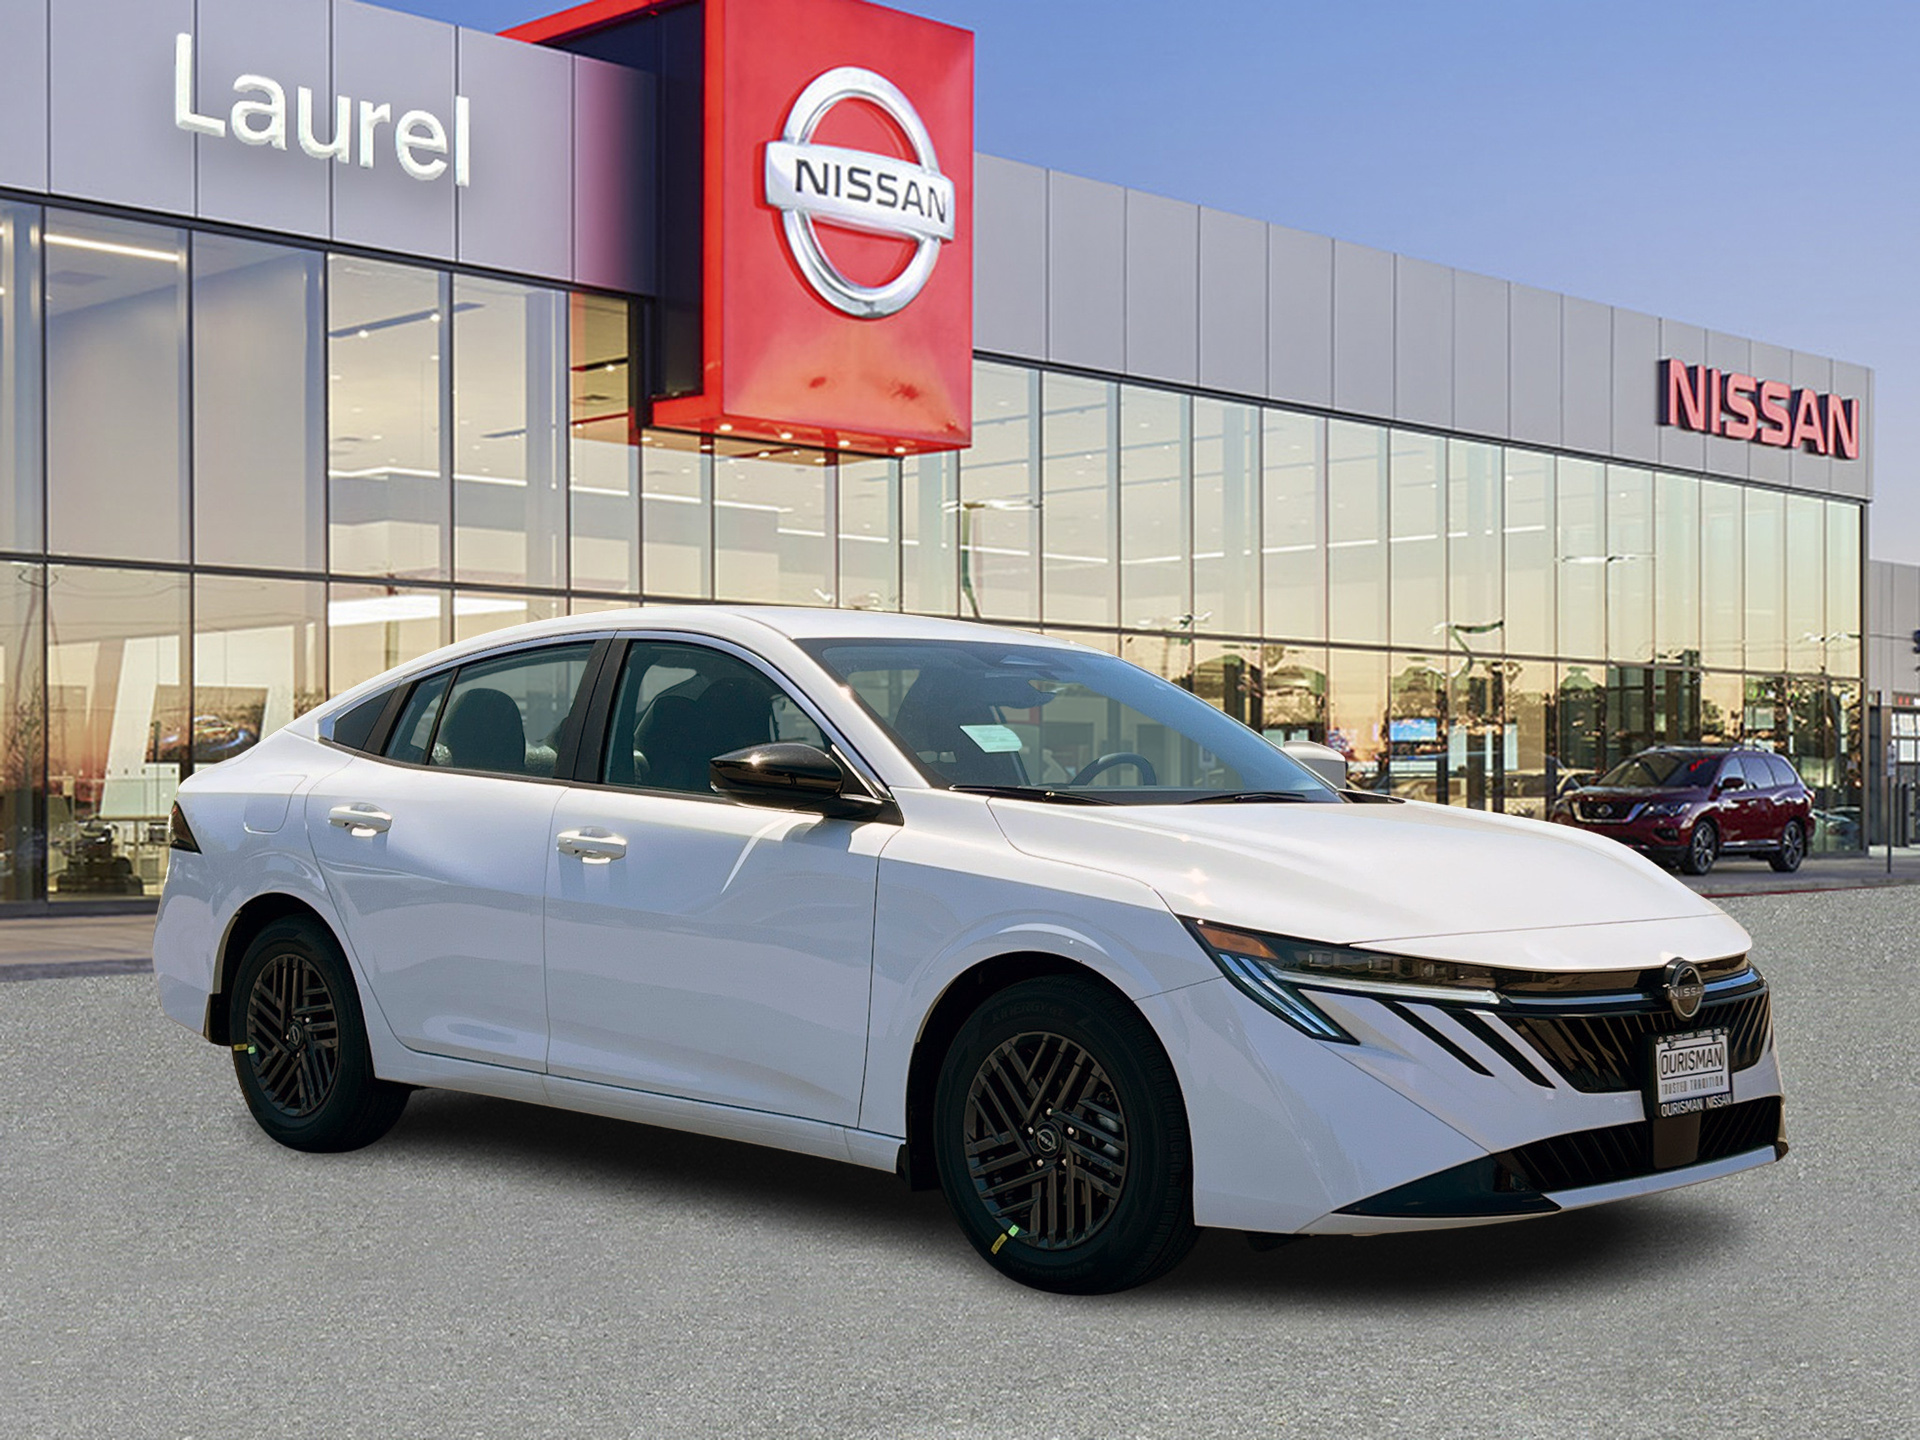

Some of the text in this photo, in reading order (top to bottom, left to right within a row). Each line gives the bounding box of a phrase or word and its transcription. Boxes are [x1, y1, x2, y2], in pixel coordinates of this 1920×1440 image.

[175, 32, 469, 188] Laurel
[794, 158, 946, 224] NISSAN
[1658, 358, 1859, 460] NISSAN
[1670, 986, 1703, 998] NISSA
[1661, 1047, 1722, 1075] OURISMAN
[1661, 1080, 1688, 1095] TRUSTED
[1661, 1093, 1732, 1117] OURISMAN NISSAN
